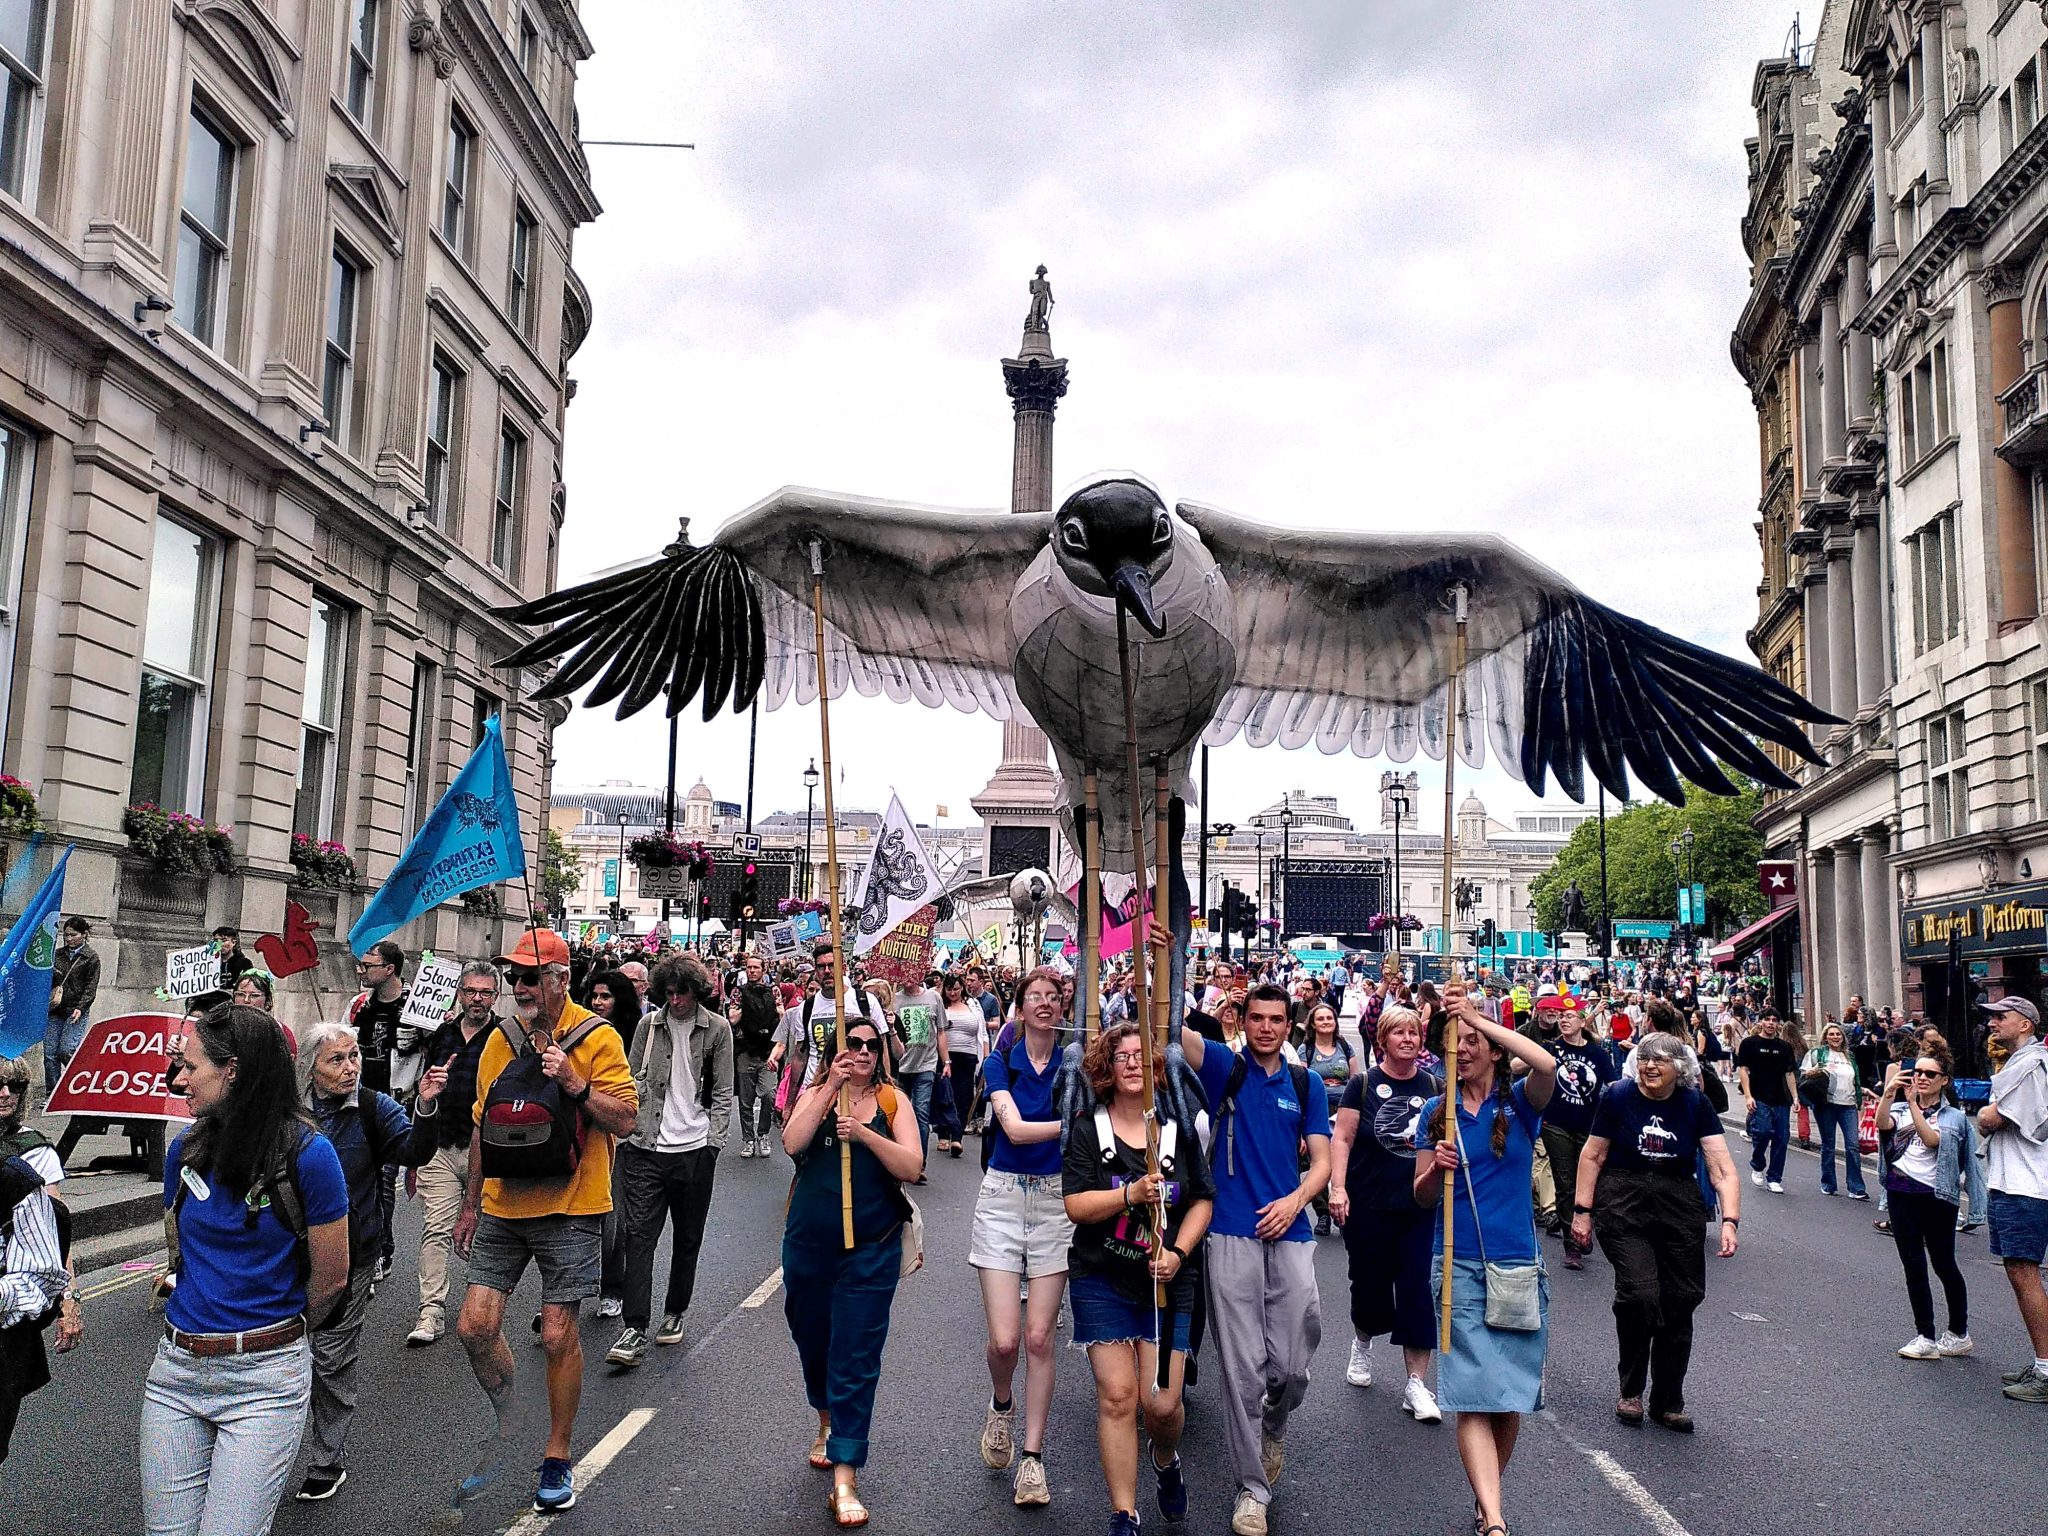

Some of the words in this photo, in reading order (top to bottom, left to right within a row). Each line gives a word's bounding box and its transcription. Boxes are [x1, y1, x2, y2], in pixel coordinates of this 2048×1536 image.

[748, 838, 756, 849] P
[174, 946, 209, 966] Stand
[879, 938, 922, 961] NURTURE
[420, 965, 461, 989] Stand
[407, 1000, 446, 1020] Natur
[100, 1030, 166, 1057] ROA
[68, 1070, 190, 1100] CLOSE
